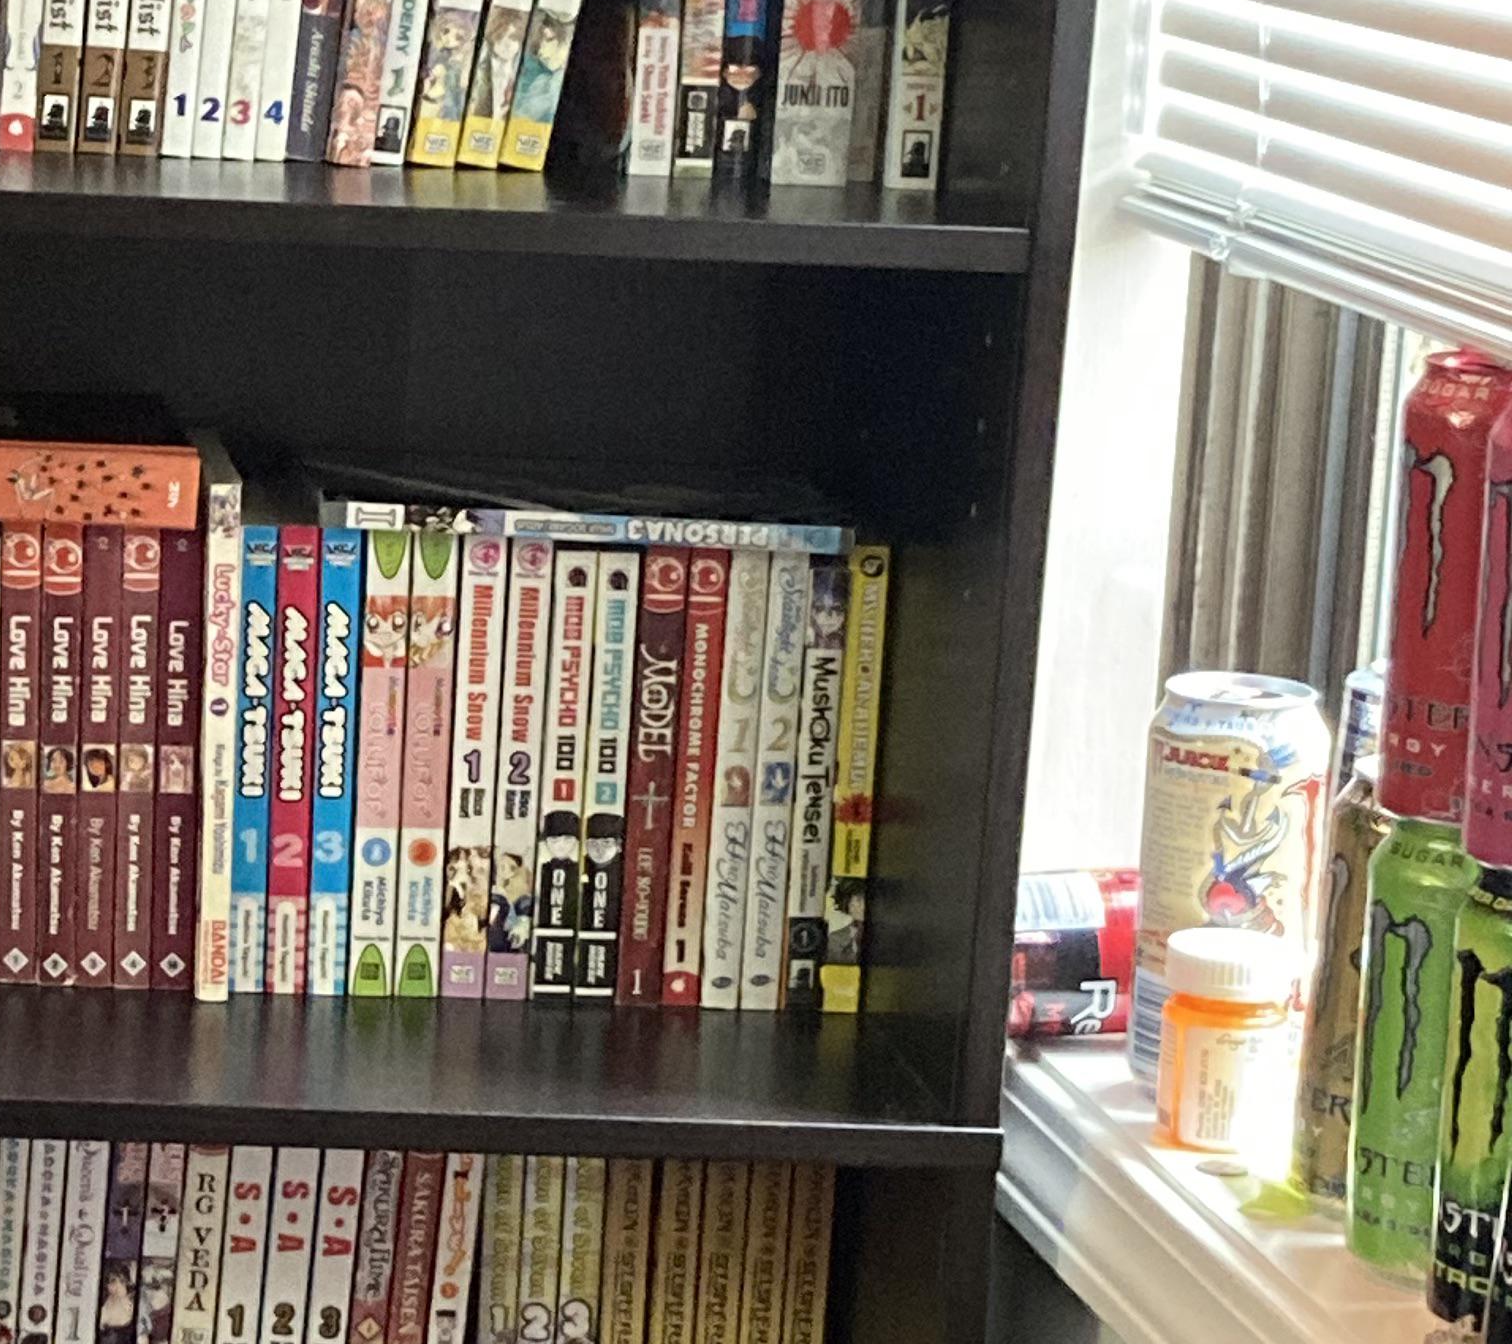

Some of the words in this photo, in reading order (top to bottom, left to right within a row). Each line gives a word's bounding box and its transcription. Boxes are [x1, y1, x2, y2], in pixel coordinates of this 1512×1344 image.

[264, 100, 284, 125] 4
[825, 85, 850, 108] ITO
[9, 615, 31, 671] Love
[53, 616, 74, 669] Love
[91, 616, 113, 669] Love
[130, 615, 152, 668] Love
[168, 621, 189, 673] Love
[468, 585, 494, 685] Millennium
[514, 587, 540, 687] Millennium
[8, 676, 30, 726] Hina
[51, 675, 73, 723] Hina
[91, 675, 113, 723] Hina
[129, 675, 151, 724] Hina
[167, 679, 189, 727] Hina
[558, 645, 582, 728] PSYCHO
[600, 648, 624, 730] PSYCHO
[639, 644, 678, 763] MODEL
[687, 623, 709, 758] MONOCHROME
[808, 658, 837, 766] Mushoku
[465, 692, 487, 742] Snow
[511, 694, 534, 744] Snow
[555, 734, 576, 771] 100
[597, 737, 617, 774] 100
[1164, 747, 1230, 772] JUICE
[682, 763, 701, 828] FACTOR
[801, 766, 830, 843] Tensei
[272, 834, 303, 868] 2
[316, 831, 345, 864] 3
[550, 871, 566, 925] ONE
[593, 873, 608, 928] ONE
[211, 920, 227, 986] BANDAI
[196, 1174, 215, 1214] RG
[185, 1228, 213, 1312] VEDA
